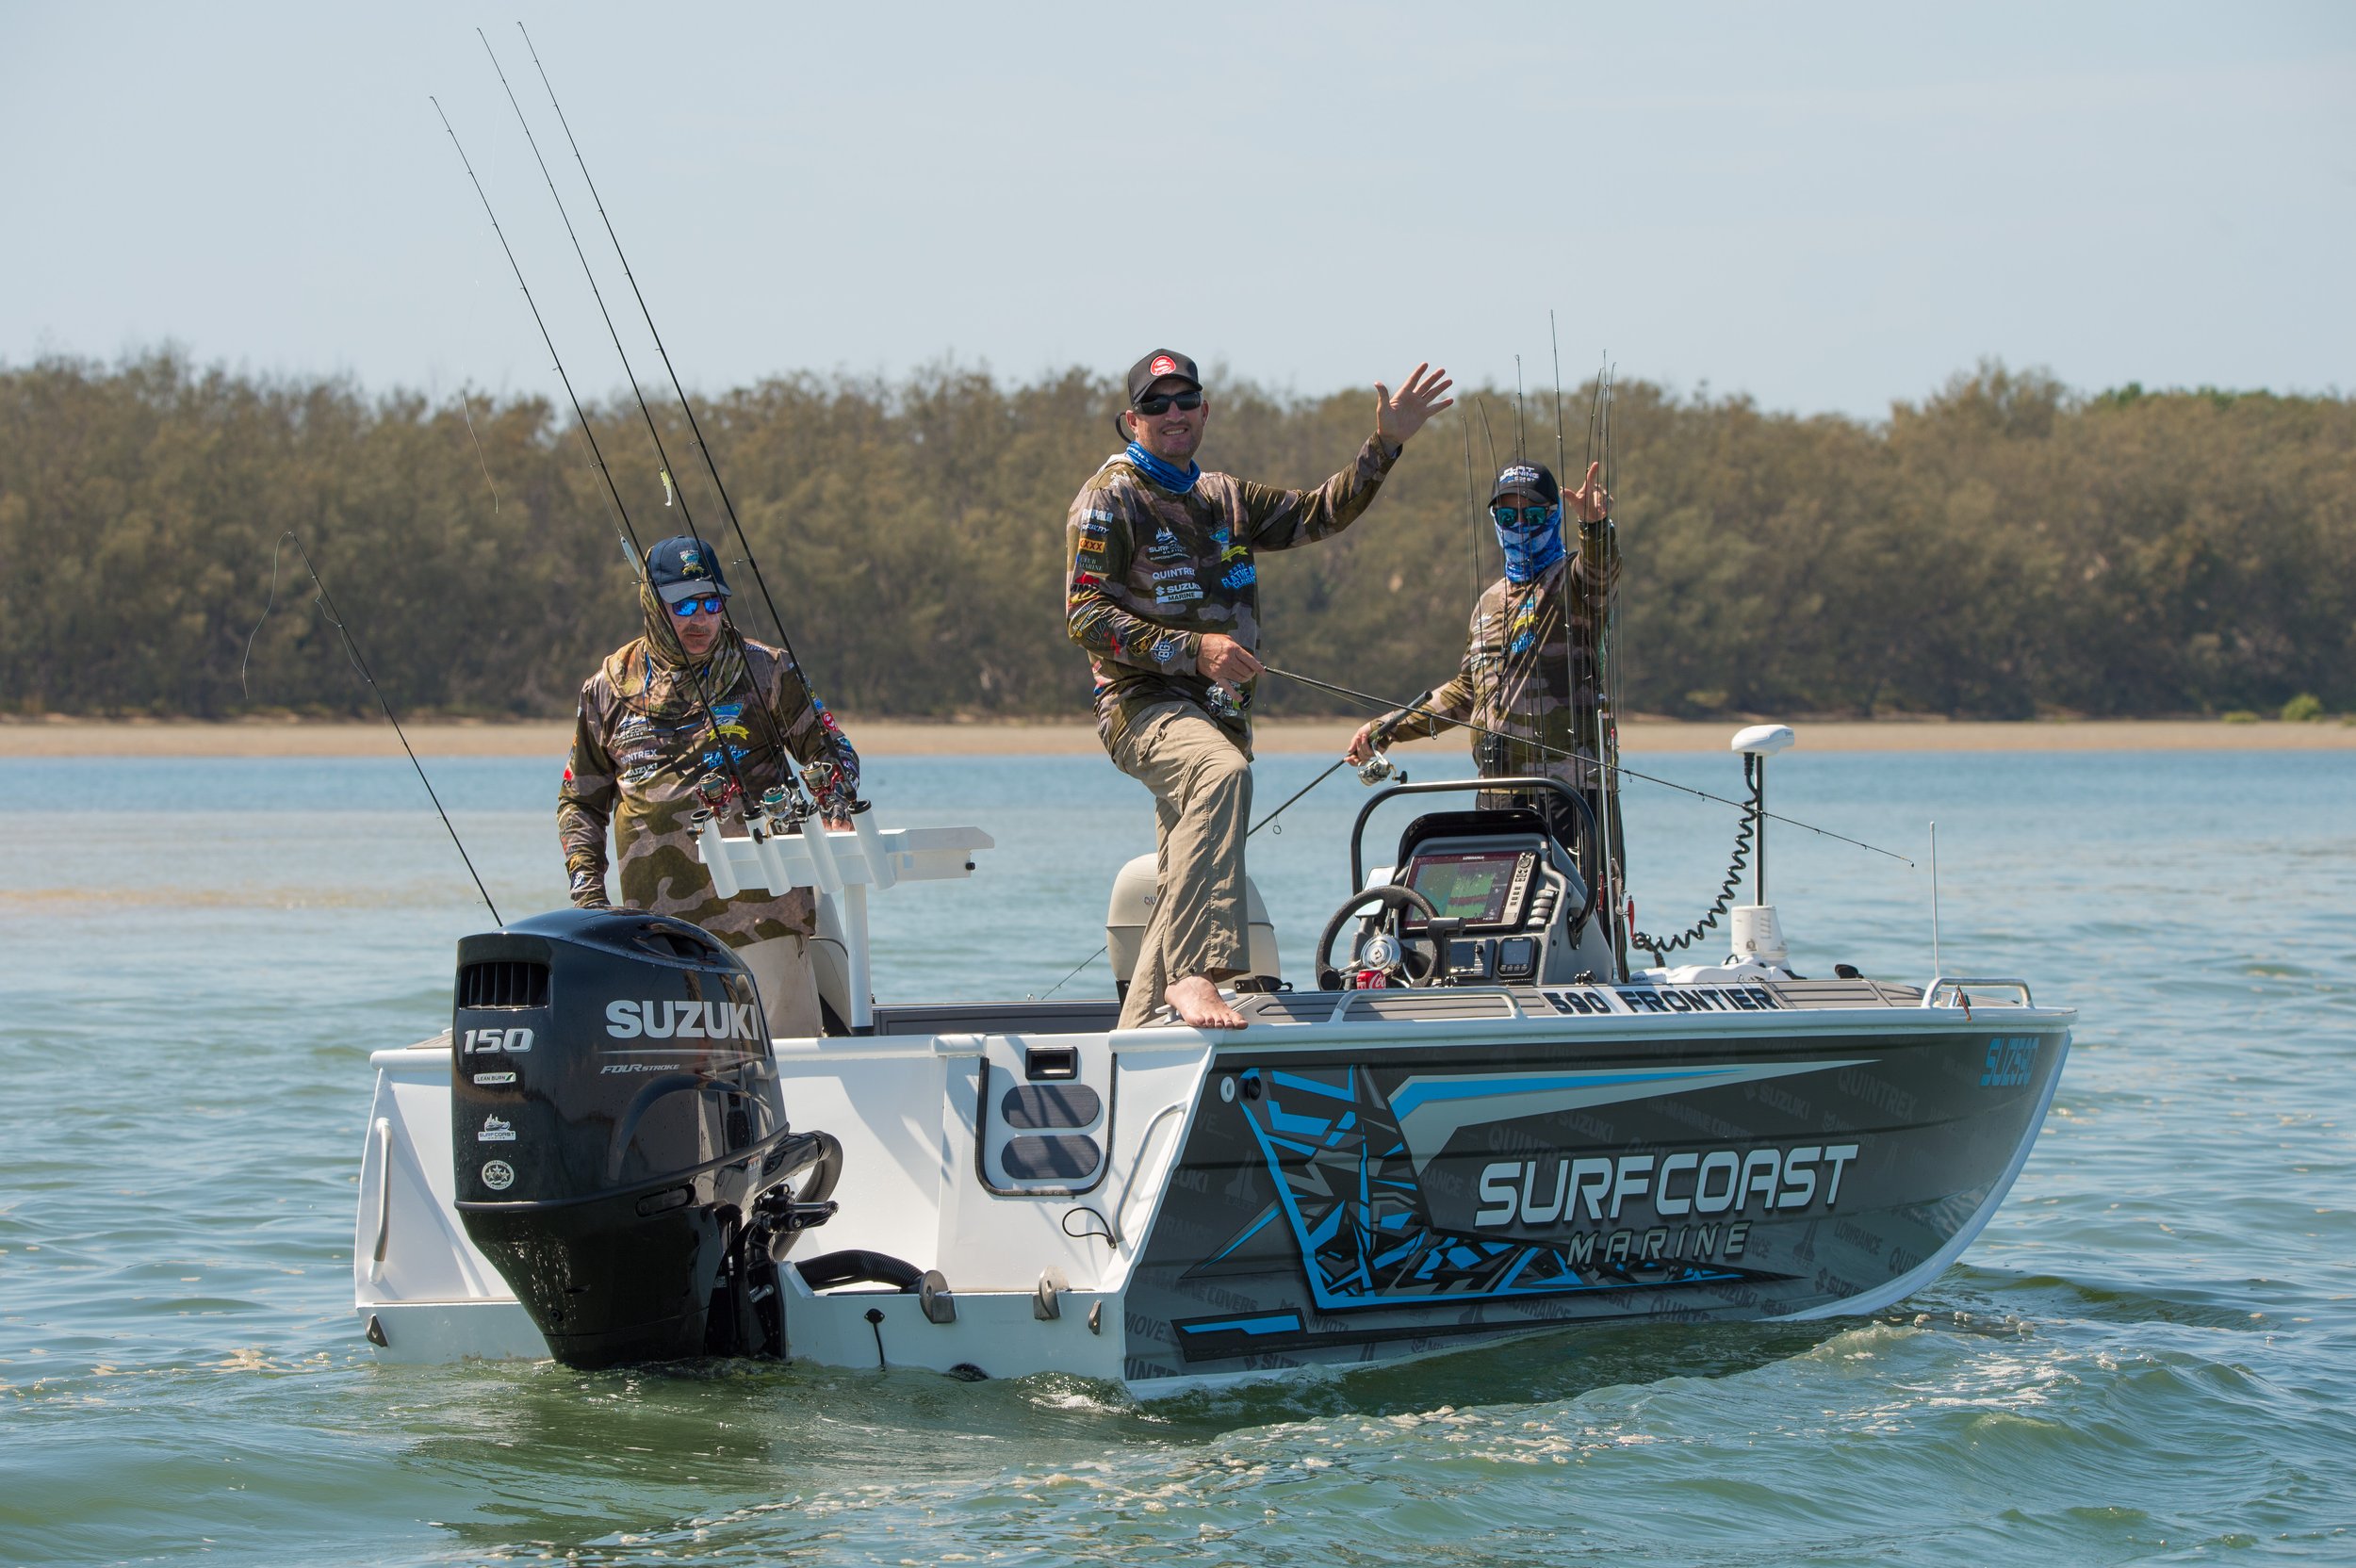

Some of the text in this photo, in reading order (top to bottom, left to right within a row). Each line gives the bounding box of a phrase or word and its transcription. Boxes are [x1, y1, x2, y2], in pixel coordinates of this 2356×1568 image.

[1167, 582, 1202, 594] SUZU
[1168, 592, 1195, 601] MARINE
[1541, 988, 1780, 1015] 590 FRONTIER
[605, 1000, 760, 1041] SUZUKI
[464, 1027, 535, 1054] 150
[1758, 1083, 1811, 1120] SUZUKI
[1838, 1069, 1919, 1120] QUINTREX
[1559, 1110, 1614, 1144] SUZUKI
[1473, 1143, 1860, 1229] SURFCOAST
[1565, 1220, 1752, 1268] MARINE
[1834, 1220, 1883, 1256] LOWRANCE
[1206, 1285, 1259, 1313] COVERS
